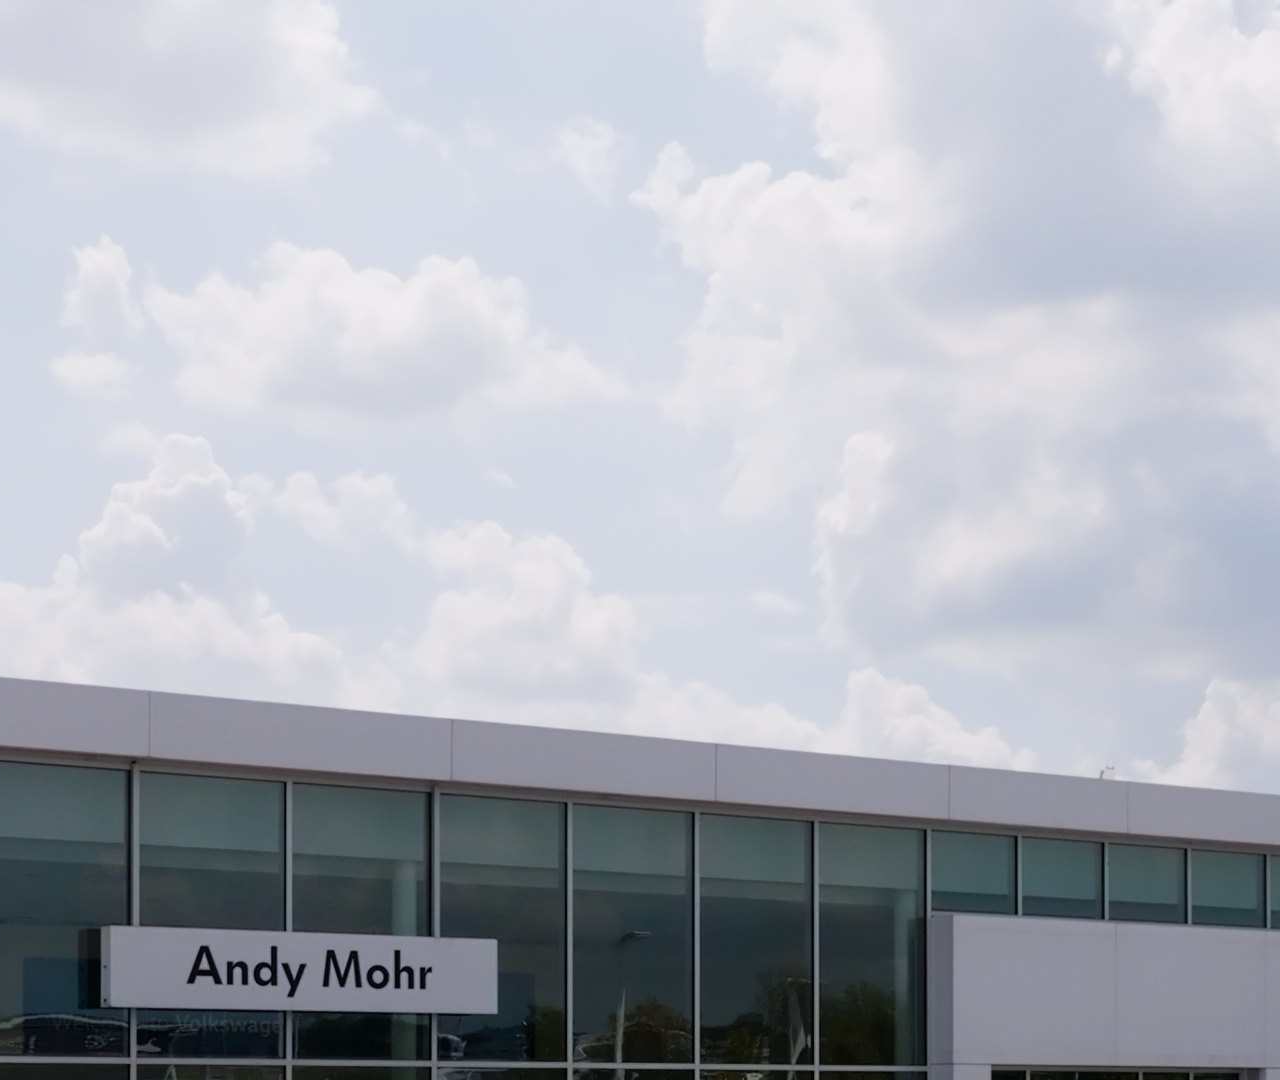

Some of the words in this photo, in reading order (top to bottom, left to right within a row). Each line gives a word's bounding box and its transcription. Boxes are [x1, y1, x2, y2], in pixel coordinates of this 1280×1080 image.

[187, 945, 307, 998] Andy
[322, 949, 432, 990] Mohr
[175, 1012, 281, 1038] Volkswage
